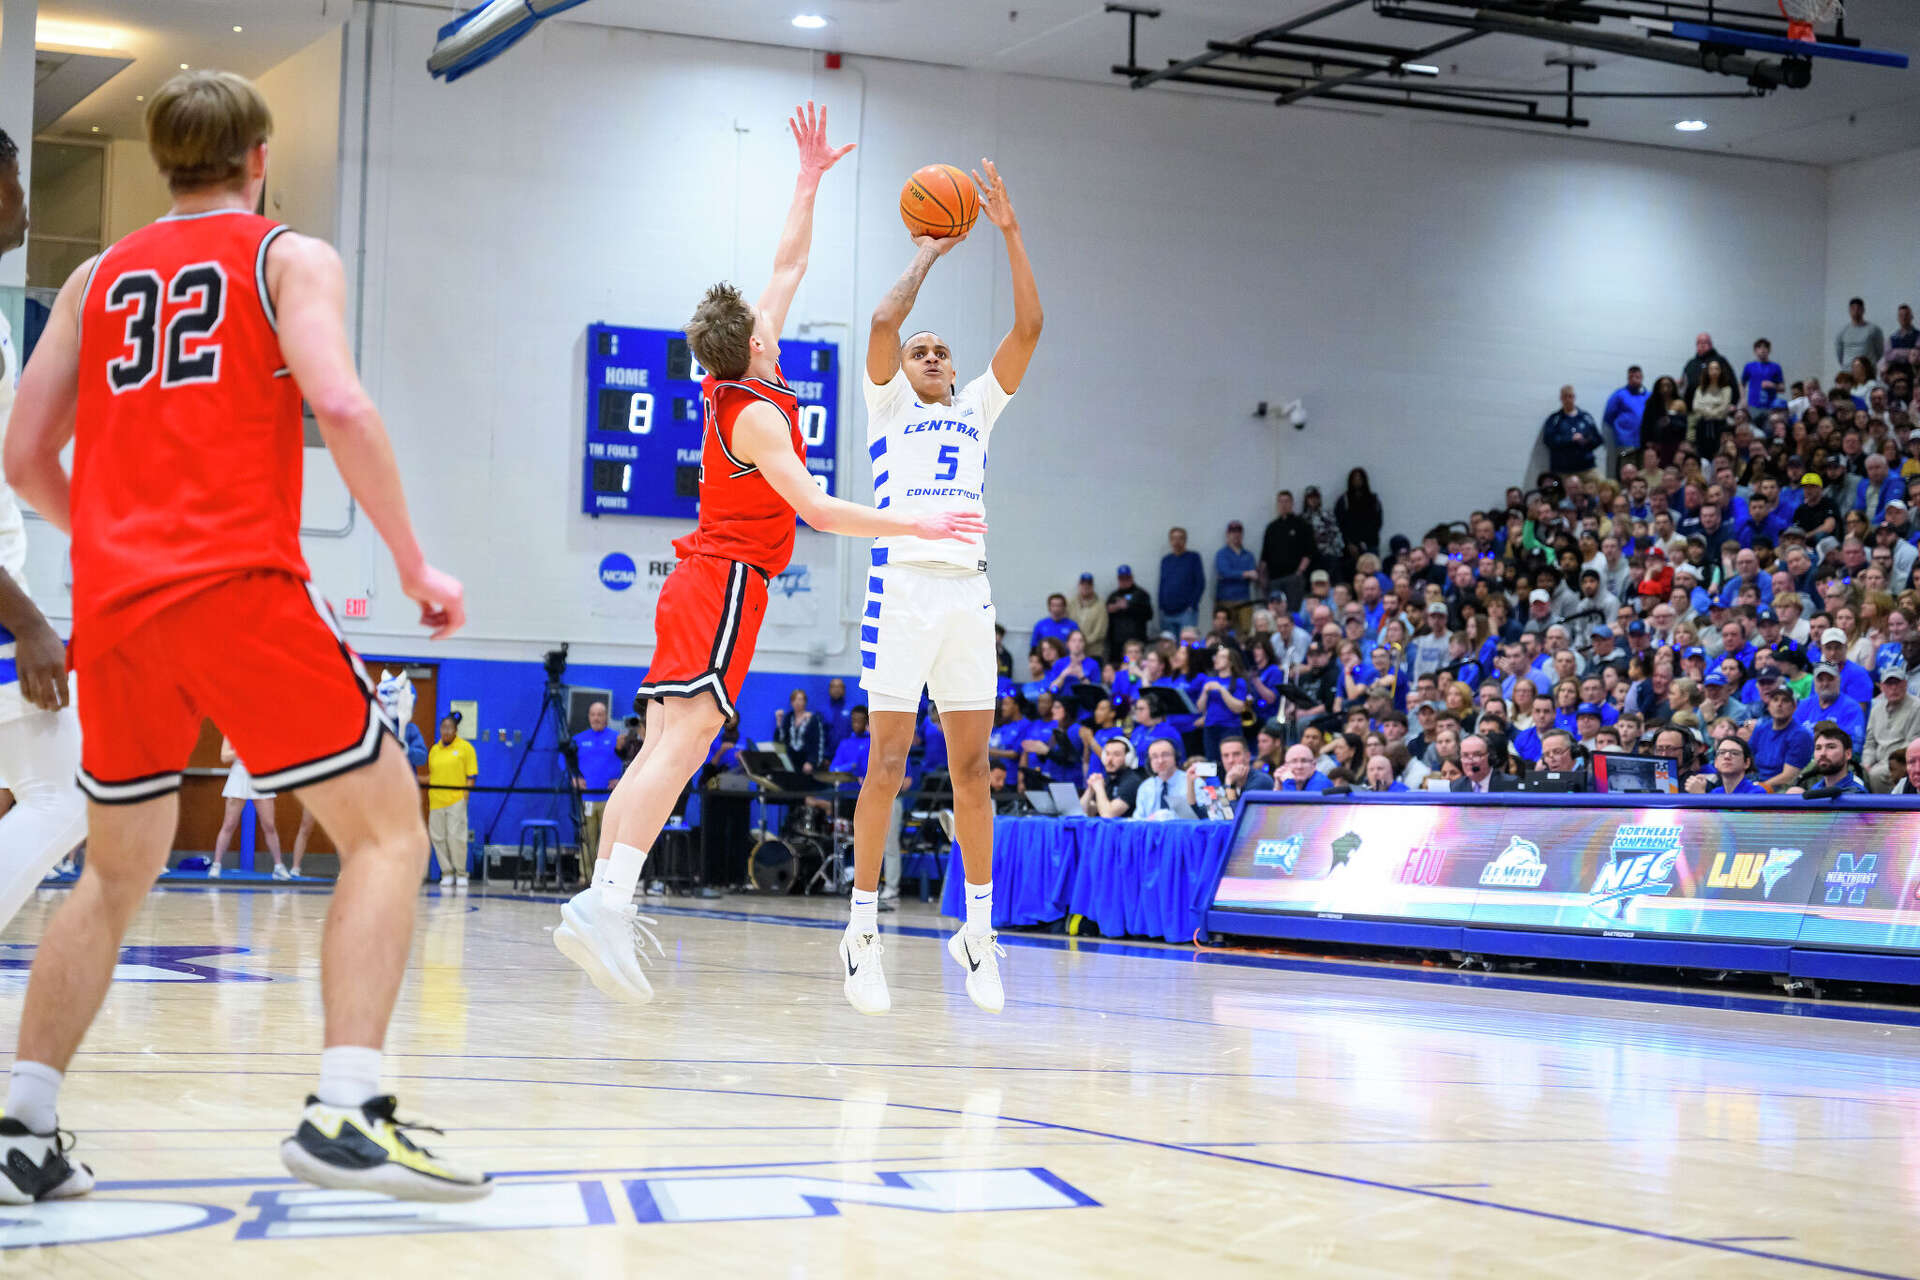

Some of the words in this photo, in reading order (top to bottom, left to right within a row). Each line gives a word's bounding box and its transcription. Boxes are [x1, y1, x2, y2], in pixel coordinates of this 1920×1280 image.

[105, 260, 228, 397] 32
[605, 366, 648, 387] HOME
[628, 392, 655, 435] 8
[903, 419, 980, 442] CENTRAL
[606, 444, 638, 459] FOULS
[934, 444, 960, 481] 5
[621, 463, 633, 493] 1
[595, 495, 629, 510] POINTS
[905, 487, 980, 501] CONNECTICUT
[344, 598, 368, 617] EXIT
[1614, 836, 1679, 849] CONFERENCE
[1617, 826, 1682, 837] NORTHEAST
[1399, 847, 1446, 885] FDU
[1590, 847, 1681, 896] NEC
[1706, 852, 1767, 889] LIU
